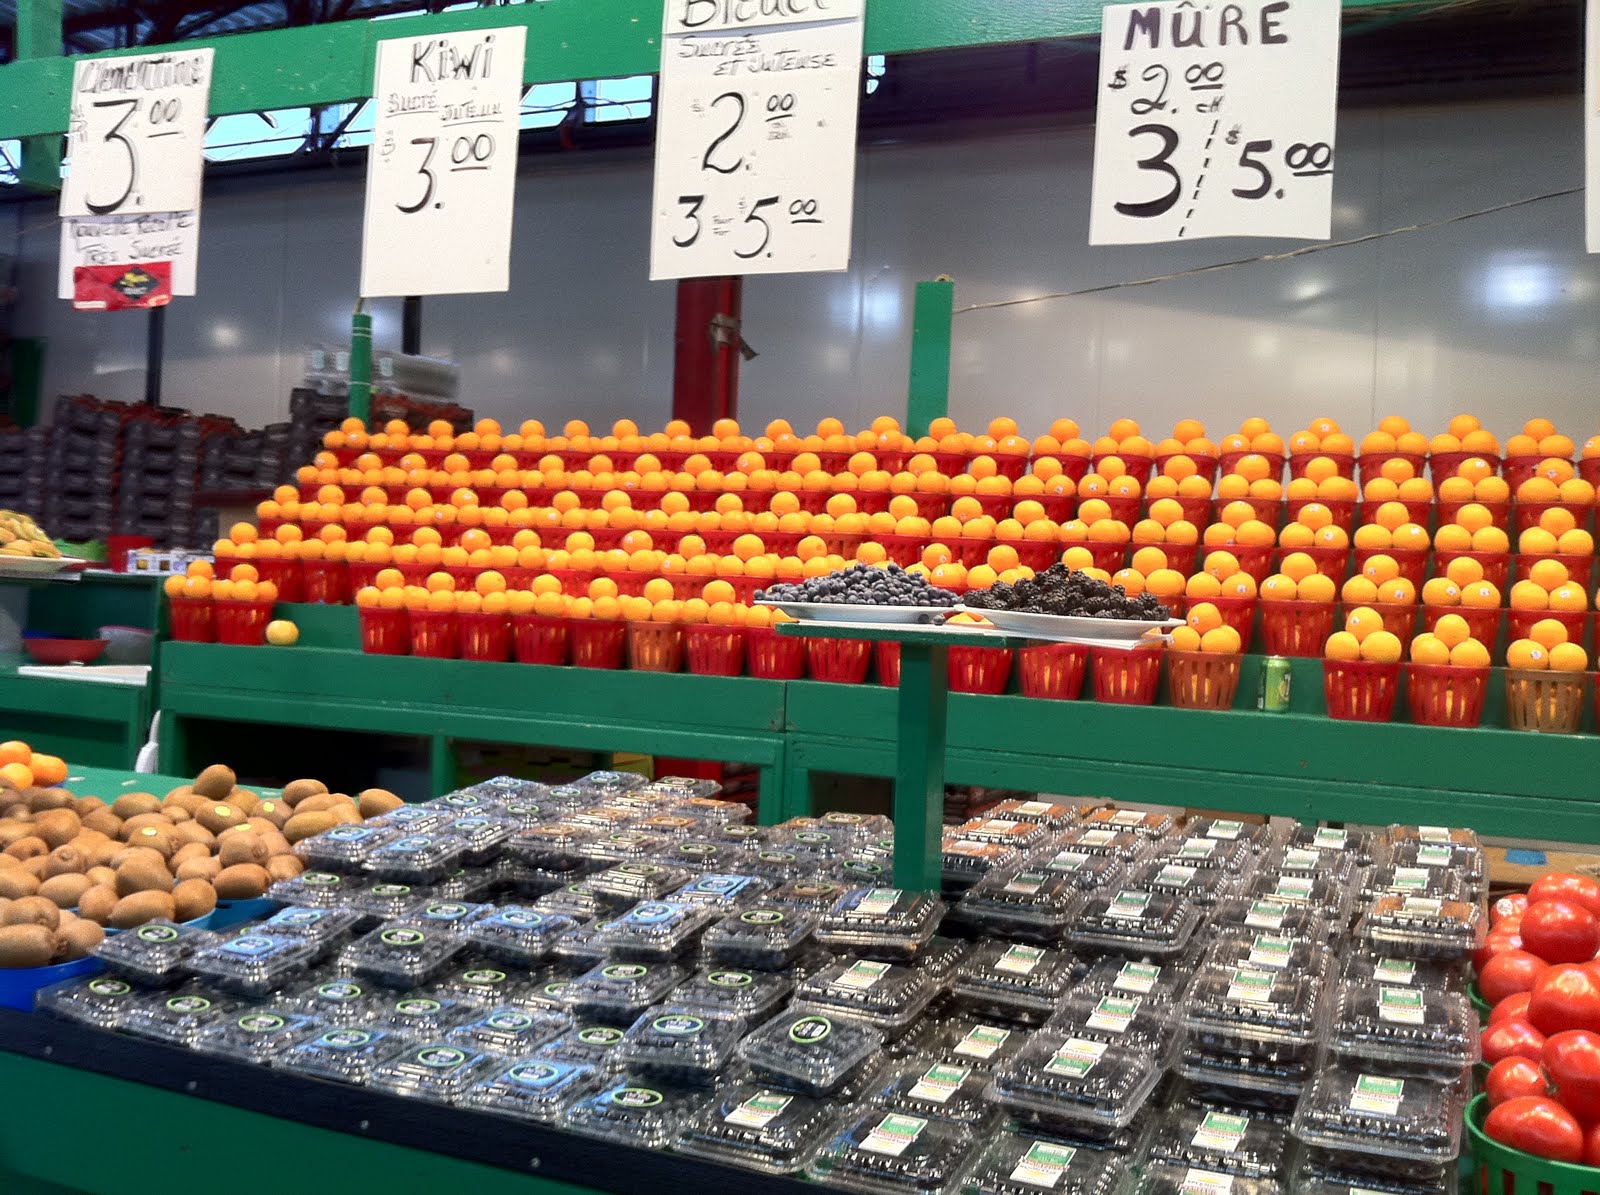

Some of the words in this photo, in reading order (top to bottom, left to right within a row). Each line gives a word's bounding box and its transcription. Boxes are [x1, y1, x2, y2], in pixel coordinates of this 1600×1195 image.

[679, 0, 830, 27] Bleue
[1124, 1, 1290, 50] MÛRE
[672, 194, 707, 248] 3
